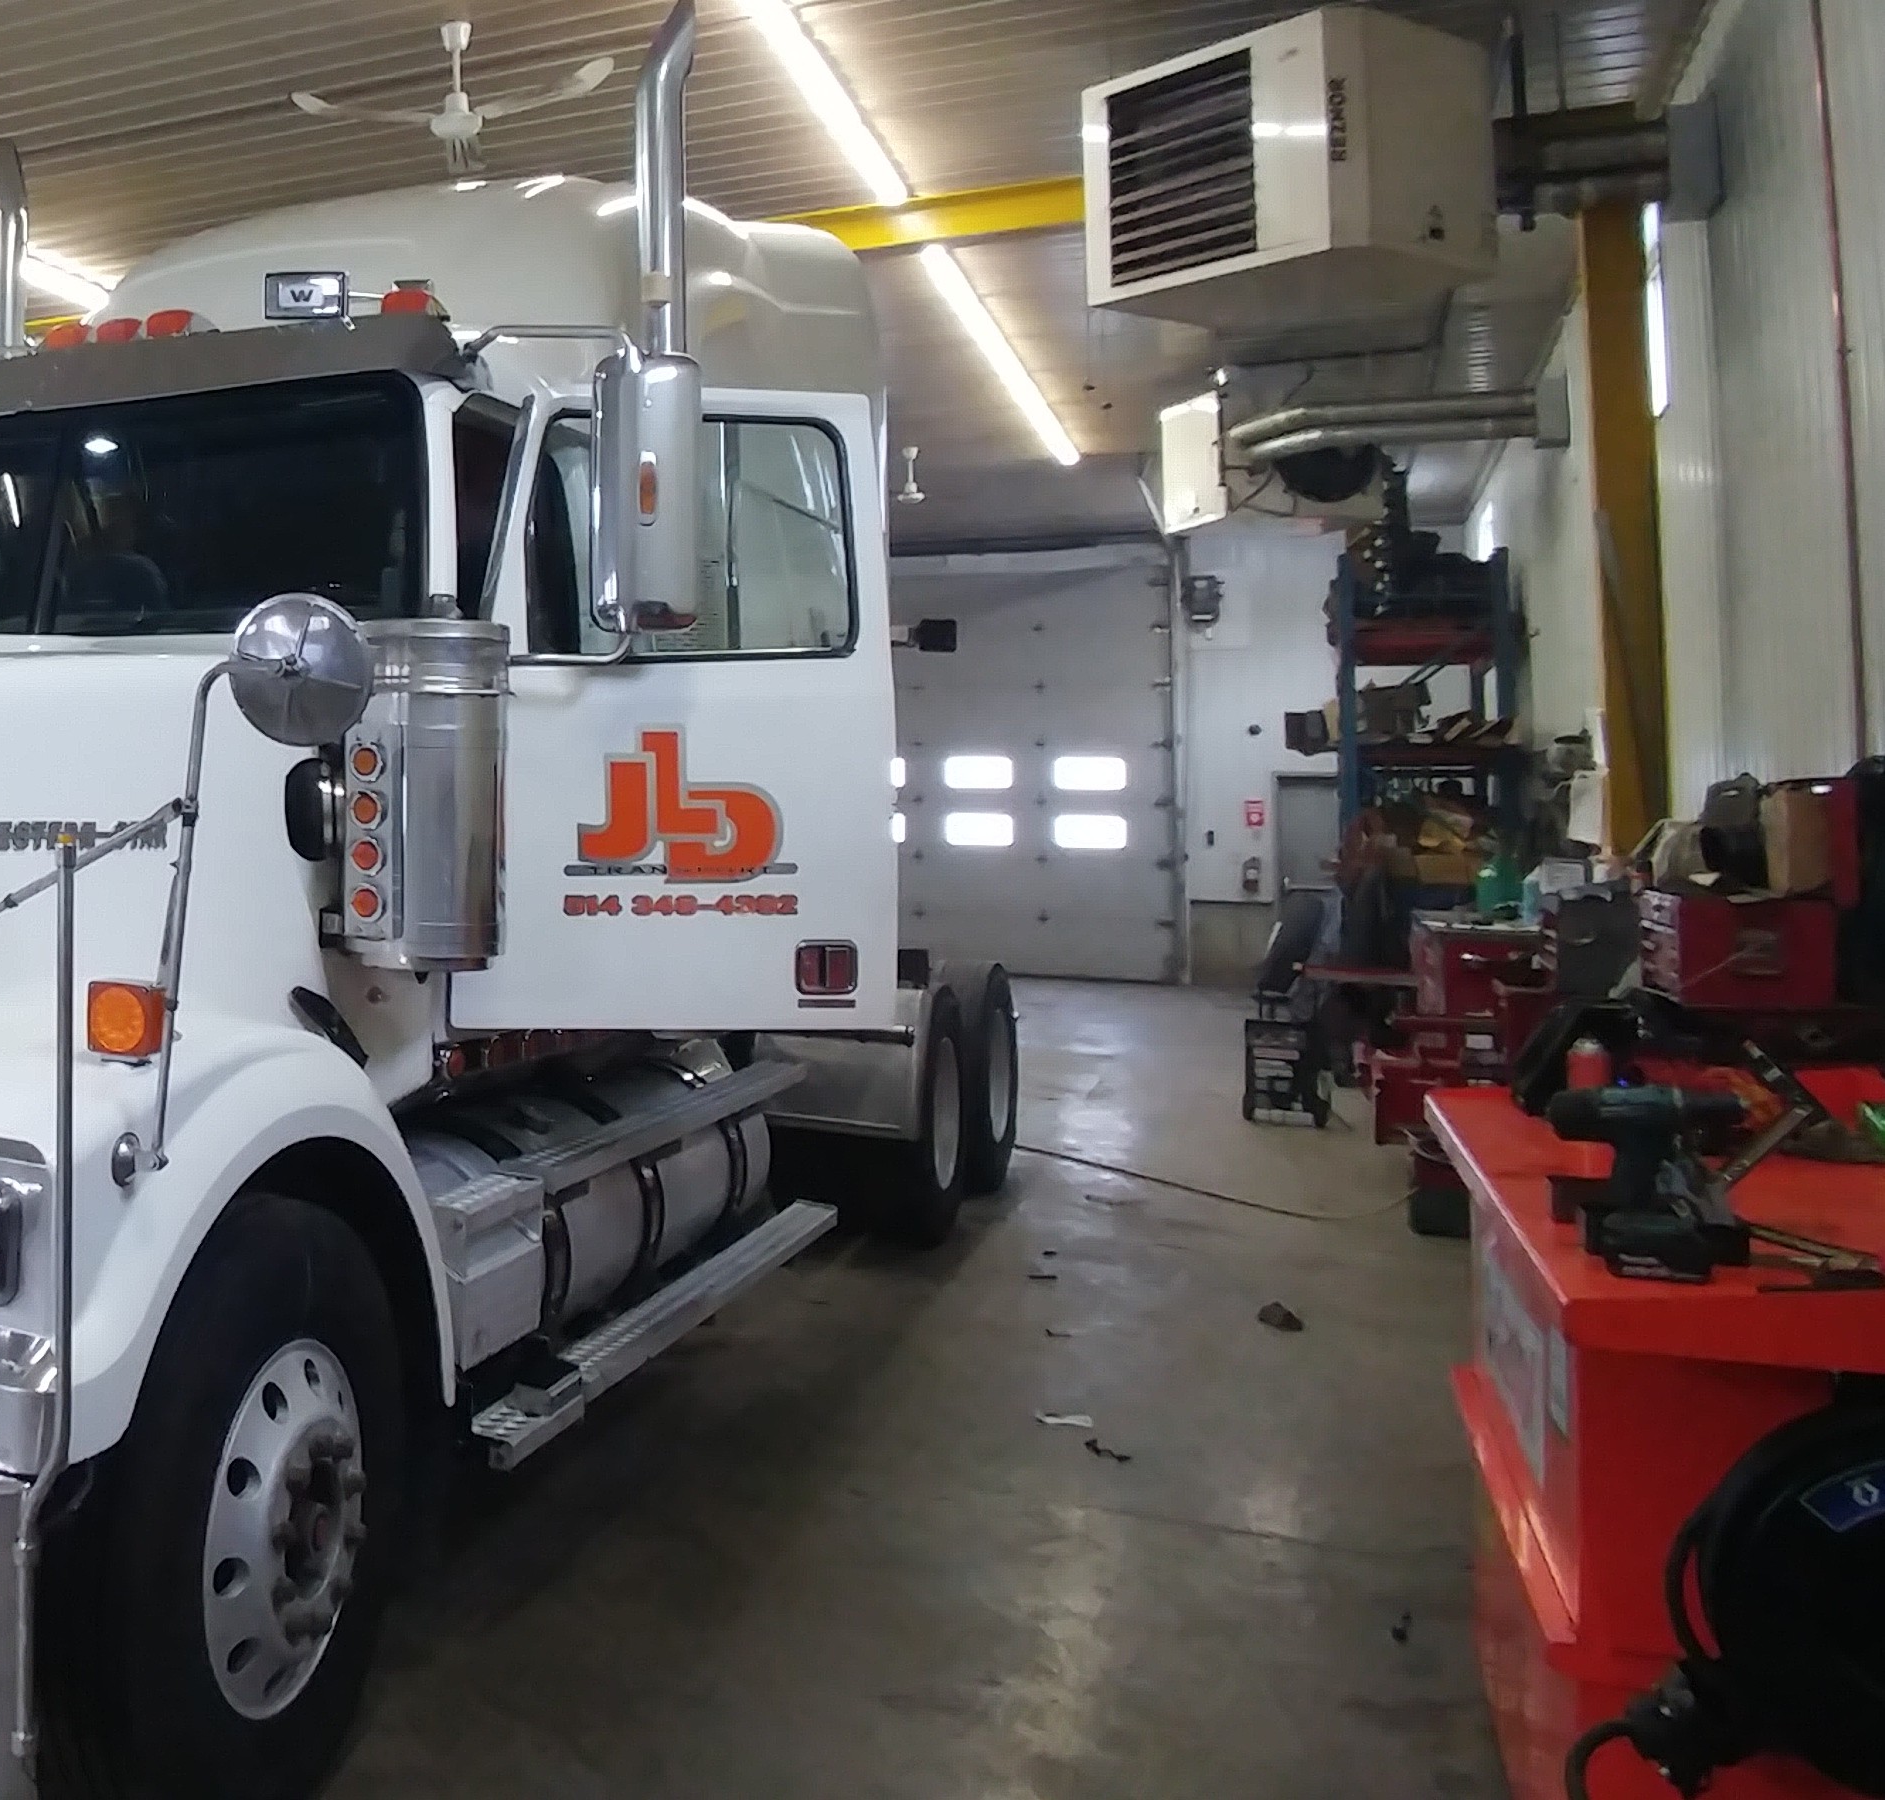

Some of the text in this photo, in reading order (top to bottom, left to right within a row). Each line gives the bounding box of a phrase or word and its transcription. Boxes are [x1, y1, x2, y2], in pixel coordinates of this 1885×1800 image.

[1327, 77, 1347, 162] REZNOR
[289, 289, 314, 303] W
[563, 894, 622, 916] 514
